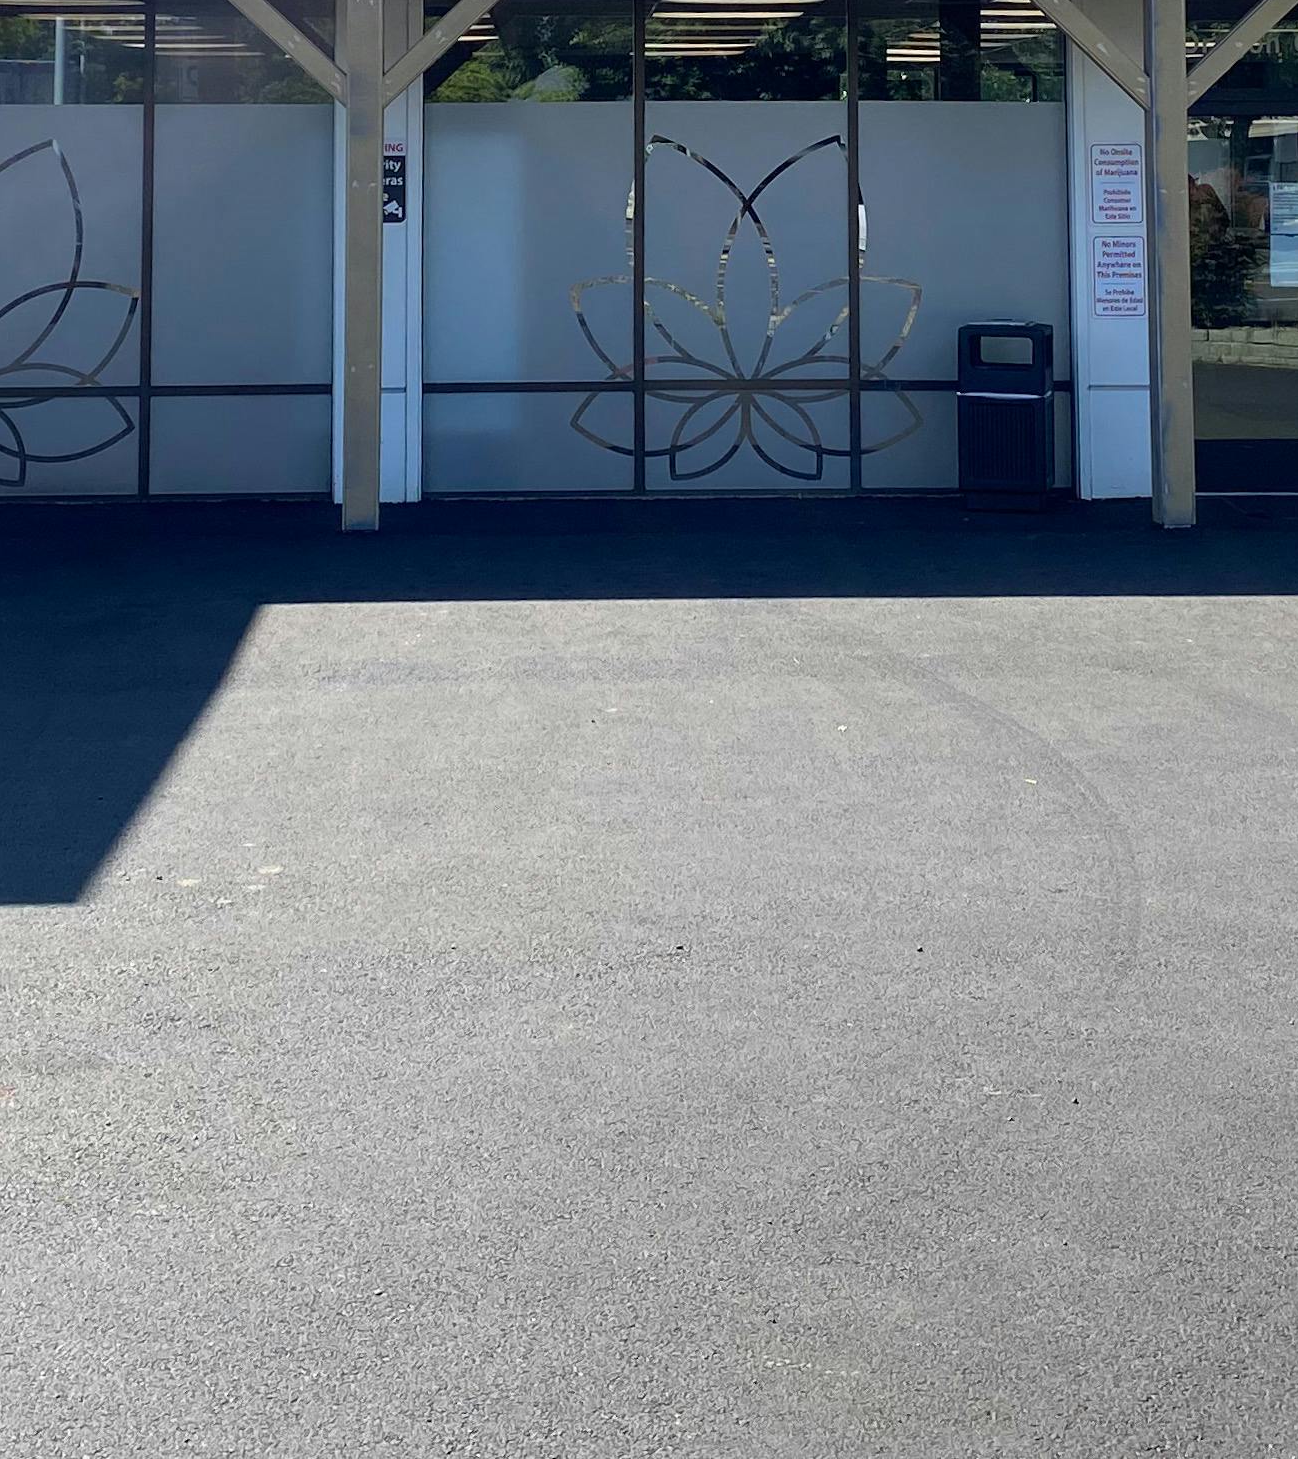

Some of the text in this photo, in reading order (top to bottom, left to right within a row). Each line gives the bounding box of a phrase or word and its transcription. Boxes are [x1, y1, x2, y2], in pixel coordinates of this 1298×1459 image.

[1185, 29, 1280, 54] Oron
[1094, 158, 1139, 167] Consumption
[1104, 169, 1138, 178] Marijuana
[1103, 250, 1135, 258] Permitted
[1097, 261, 1131, 269] Anywhere
